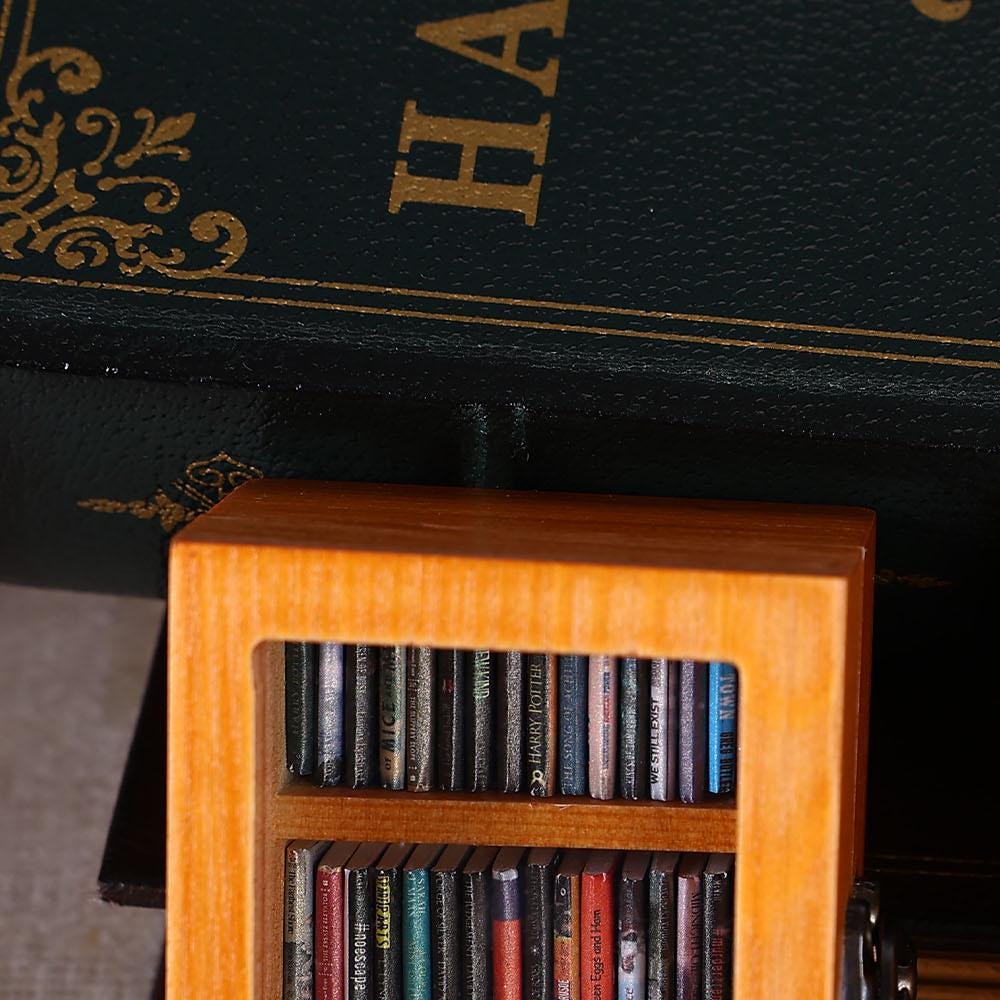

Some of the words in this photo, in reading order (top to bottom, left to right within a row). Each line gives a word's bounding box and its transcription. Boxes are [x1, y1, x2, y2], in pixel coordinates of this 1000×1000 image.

[388, 0, 569, 227] HA
[529, 663, 542, 713] POTTER
[719, 674, 735, 720] TOWN
[382, 701, 395, 752] MICE
[564, 706, 573, 720] OF
[650, 697, 659, 730] EXIST
[529, 719, 542, 764] HARRY
[564, 726, 573, 762] SONG
[650, 733, 659, 764] STILL
[564, 765, 573, 787] THE
[650, 767, 659, 784] WE
[288, 871, 296, 884] The
[465, 880, 474, 898] THE
[288, 886, 296, 912] Farthest
[590, 910, 601, 933] Ham
[351, 923, 369, 991] #noescape
[590, 936, 601, 954] and
[591, 957, 603, 981] Eggs
